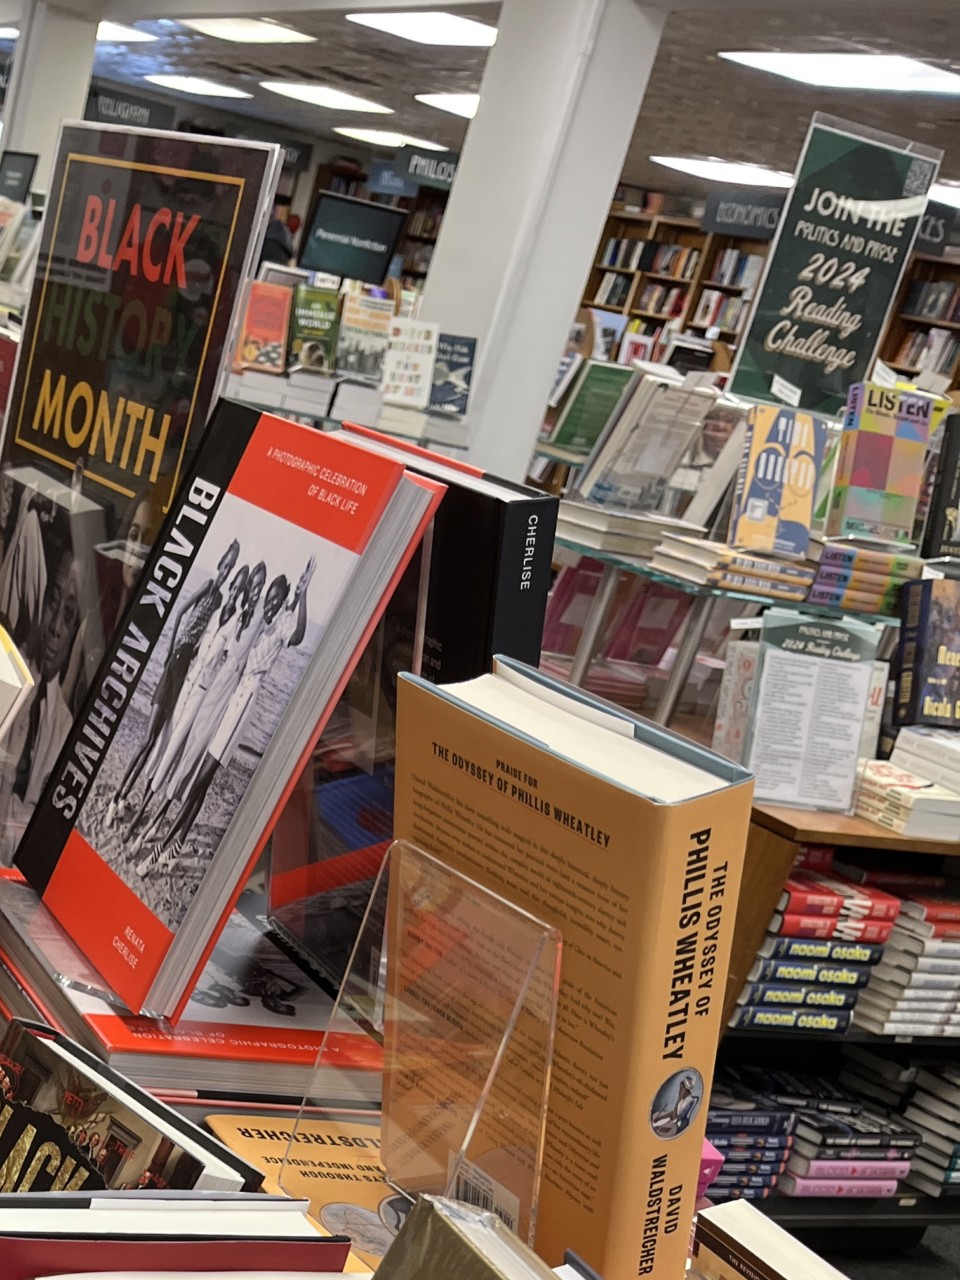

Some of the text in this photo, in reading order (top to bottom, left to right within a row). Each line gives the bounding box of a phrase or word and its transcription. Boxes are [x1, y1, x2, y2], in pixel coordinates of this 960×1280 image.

[803, 188, 860, 225] JOIN
[76, 195, 201, 289] BLACK
[794, 220, 840, 248] POLITICS
[842, 233, 866, 255] AND
[798, 253, 871, 293] 2024
[43, 284, 199, 374] HISTORY
[780, 286, 863, 337] Reading
[764, 320, 857, 374] Challenge
[32, 368, 171, 483] MONTH
[867, 390, 930, 418] LISTEN
[266, 447, 368, 497] A PHOTOGRAPHIC CELEBRATION
[307, 484, 359, 515] OF BLACK LIFE
[520, 515, 539, 590] CHERLISE
[52, 476, 221, 820] BLACK ARCHIVES
[432, 742, 611, 848] THE ODYSSEY OF PHILLIS WHEATLEY
[496, 759, 538, 790] PRAISE FOR
[112, 935, 139, 970] CHERLISE
[123, 925, 146, 954] RENATA
[663, 828, 712, 1061] PHILLIS WHEATLEY
[694, 861, 729, 1017] THE ODYSSEY OF
[790, 942, 871, 961] naomi osaka
[764, 987, 845, 1006] naomi osaka
[776, 964, 858, 984] naomi osaka
[755, 1010, 837, 1029] naomi osaka
[638, 1154, 668, 1277] WALDSTREICHER
[664, 1184, 683, 1235] DAVID
